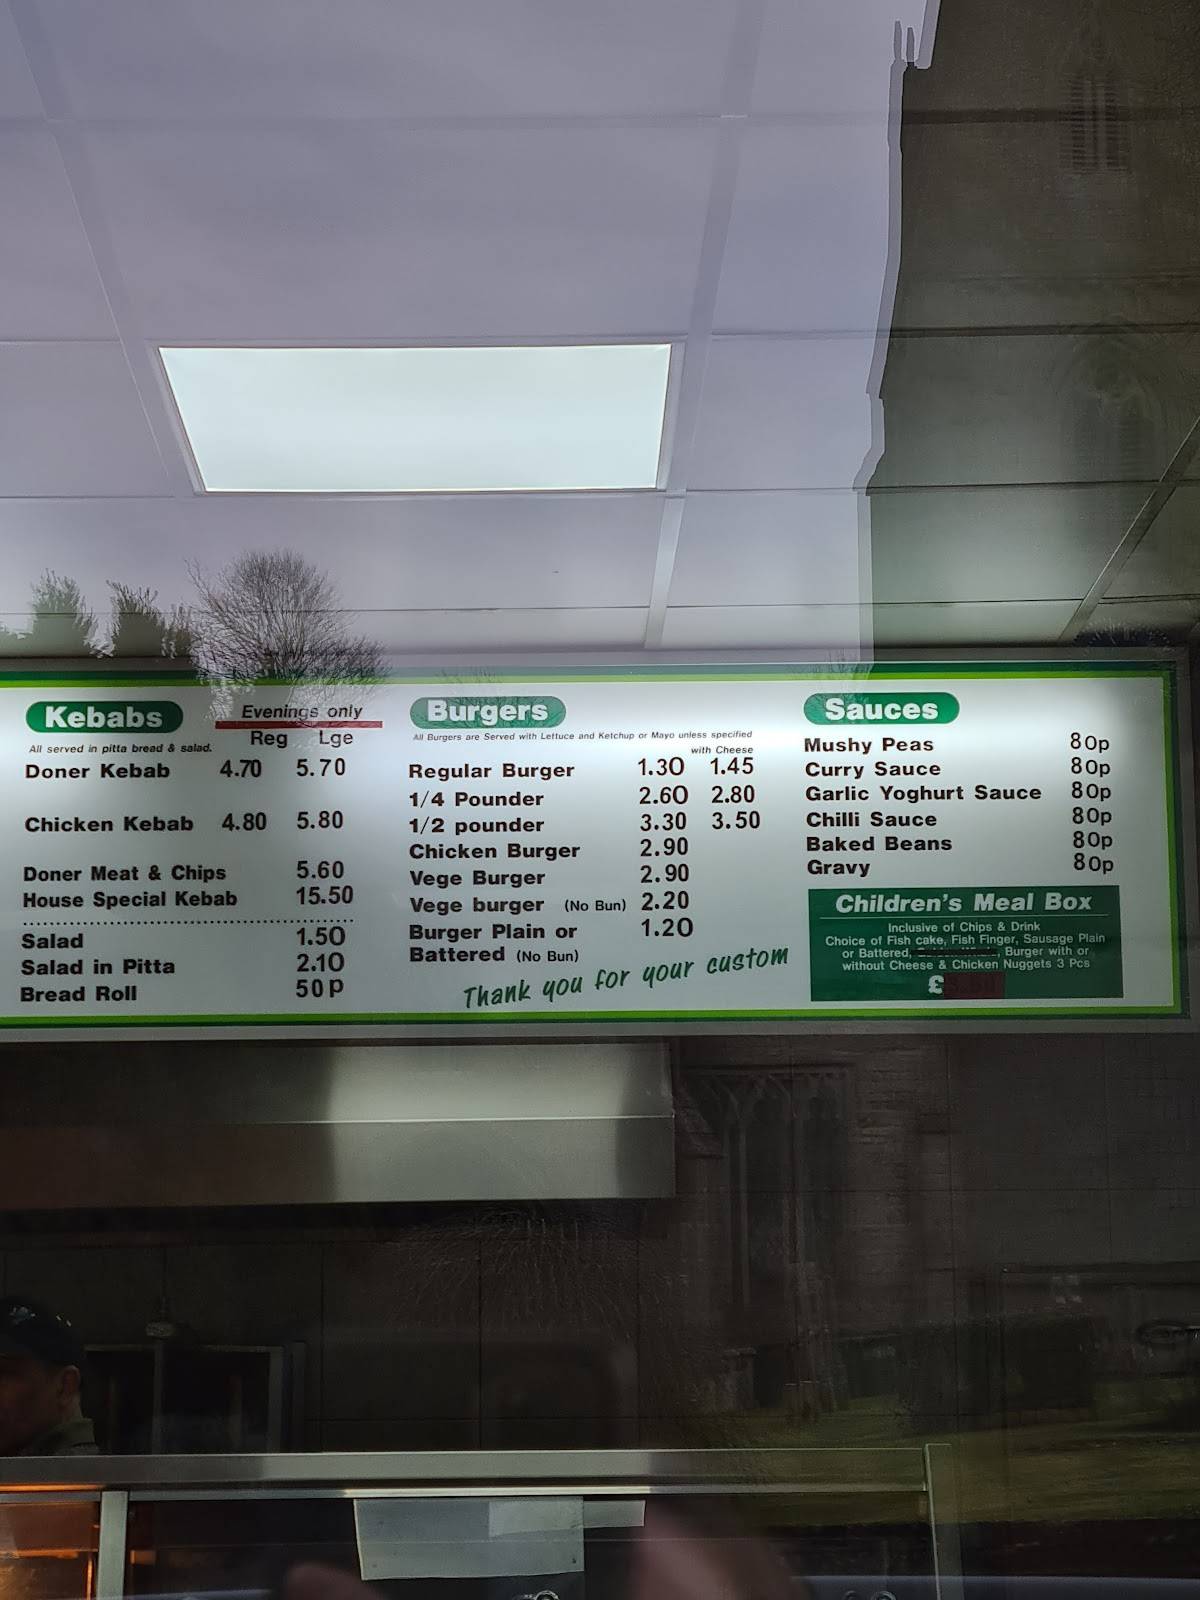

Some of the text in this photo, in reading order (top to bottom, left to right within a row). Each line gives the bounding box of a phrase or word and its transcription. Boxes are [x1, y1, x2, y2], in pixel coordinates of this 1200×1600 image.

[45, 707, 162, 728] Kebabs
[242, 704, 362, 719] Evenings only
[427, 700, 548, 724] Burgers
[825, 698, 939, 720] Sauces
[251, 730, 353, 748] Reg Lge
[428, 733, 461, 742] Burgers
[599, 732, 634, 740] Ketchup
[711, 731, 752, 739] specified
[47, 745, 84, 753] served
[102, 745, 127, 754] pitta
[132, 744, 163, 752] bread
[168, 744, 175, 752] &
[181, 744, 212, 752] salad.
[716, 746, 753, 754] Cheese
[805, 738, 872, 754] Mushy
[883, 738, 933, 751] Peas
[26, 765, 90, 778] Doner
[101, 763, 170, 778] Kebab
[220, 759, 261, 777] 4.70
[409, 757, 753, 781] Regular Burger 1.30 1.45
[806, 762, 864, 779] Curry
[875, 762, 940, 776] Sauce
[410, 785, 754, 808] 1/4 Pounder 2.60 2.80
[806, 786, 869, 801] Garlic
[880, 786, 963, 803] Yoghurt
[975, 785, 1041, 800] Sauce
[25, 811, 343, 832] Chicken Kebab 4.80 5.80
[410, 811, 760, 835] 1/2 pounder 3.30 3.50
[807, 812, 859, 827] Chilli
[871, 812, 936, 827] Sauce
[410, 837, 688, 861] Chicken Burger 2.90
[807, 836, 874, 851] Baked
[885, 836, 952, 850] Beans
[24, 861, 344, 883] Doner Meat & Chips 5.60
[410, 864, 689, 889] Vege Burger 2.90
[808, 860, 870, 877] Gravy
[24, 886, 353, 910] House Special Kebab 15.50
[410, 891, 689, 915] Vege burger (No Bun) 2.20
[974, 893, 1033, 911] Meal
[1045, 893, 1091, 910] Box
[410, 918, 693, 943] Burger Plain or 1.20
[889, 922, 1040, 933] Inclusive of Chips & Drink
[22, 926, 345, 949] Salad 1.50
[826, 933, 1105, 946] Choice of Fish cake, Fish Finger, Sausage Plain
[410, 946, 578, 962] Battered (No Bun)
[859, 948, 911, 958] Battered,
[1005, 947, 1043, 958] Burger
[1049, 946, 1072, 955] with
[21, 952, 344, 975] Salad in Pitta 2.10
[843, 958, 1090, 970] without Cheese & Chicken Nuggets 3 Pcs
[464, 948, 788, 1008] Thank you for your custom
[21, 986, 85, 1002] Bread
[96, 986, 136, 1001] Roll
